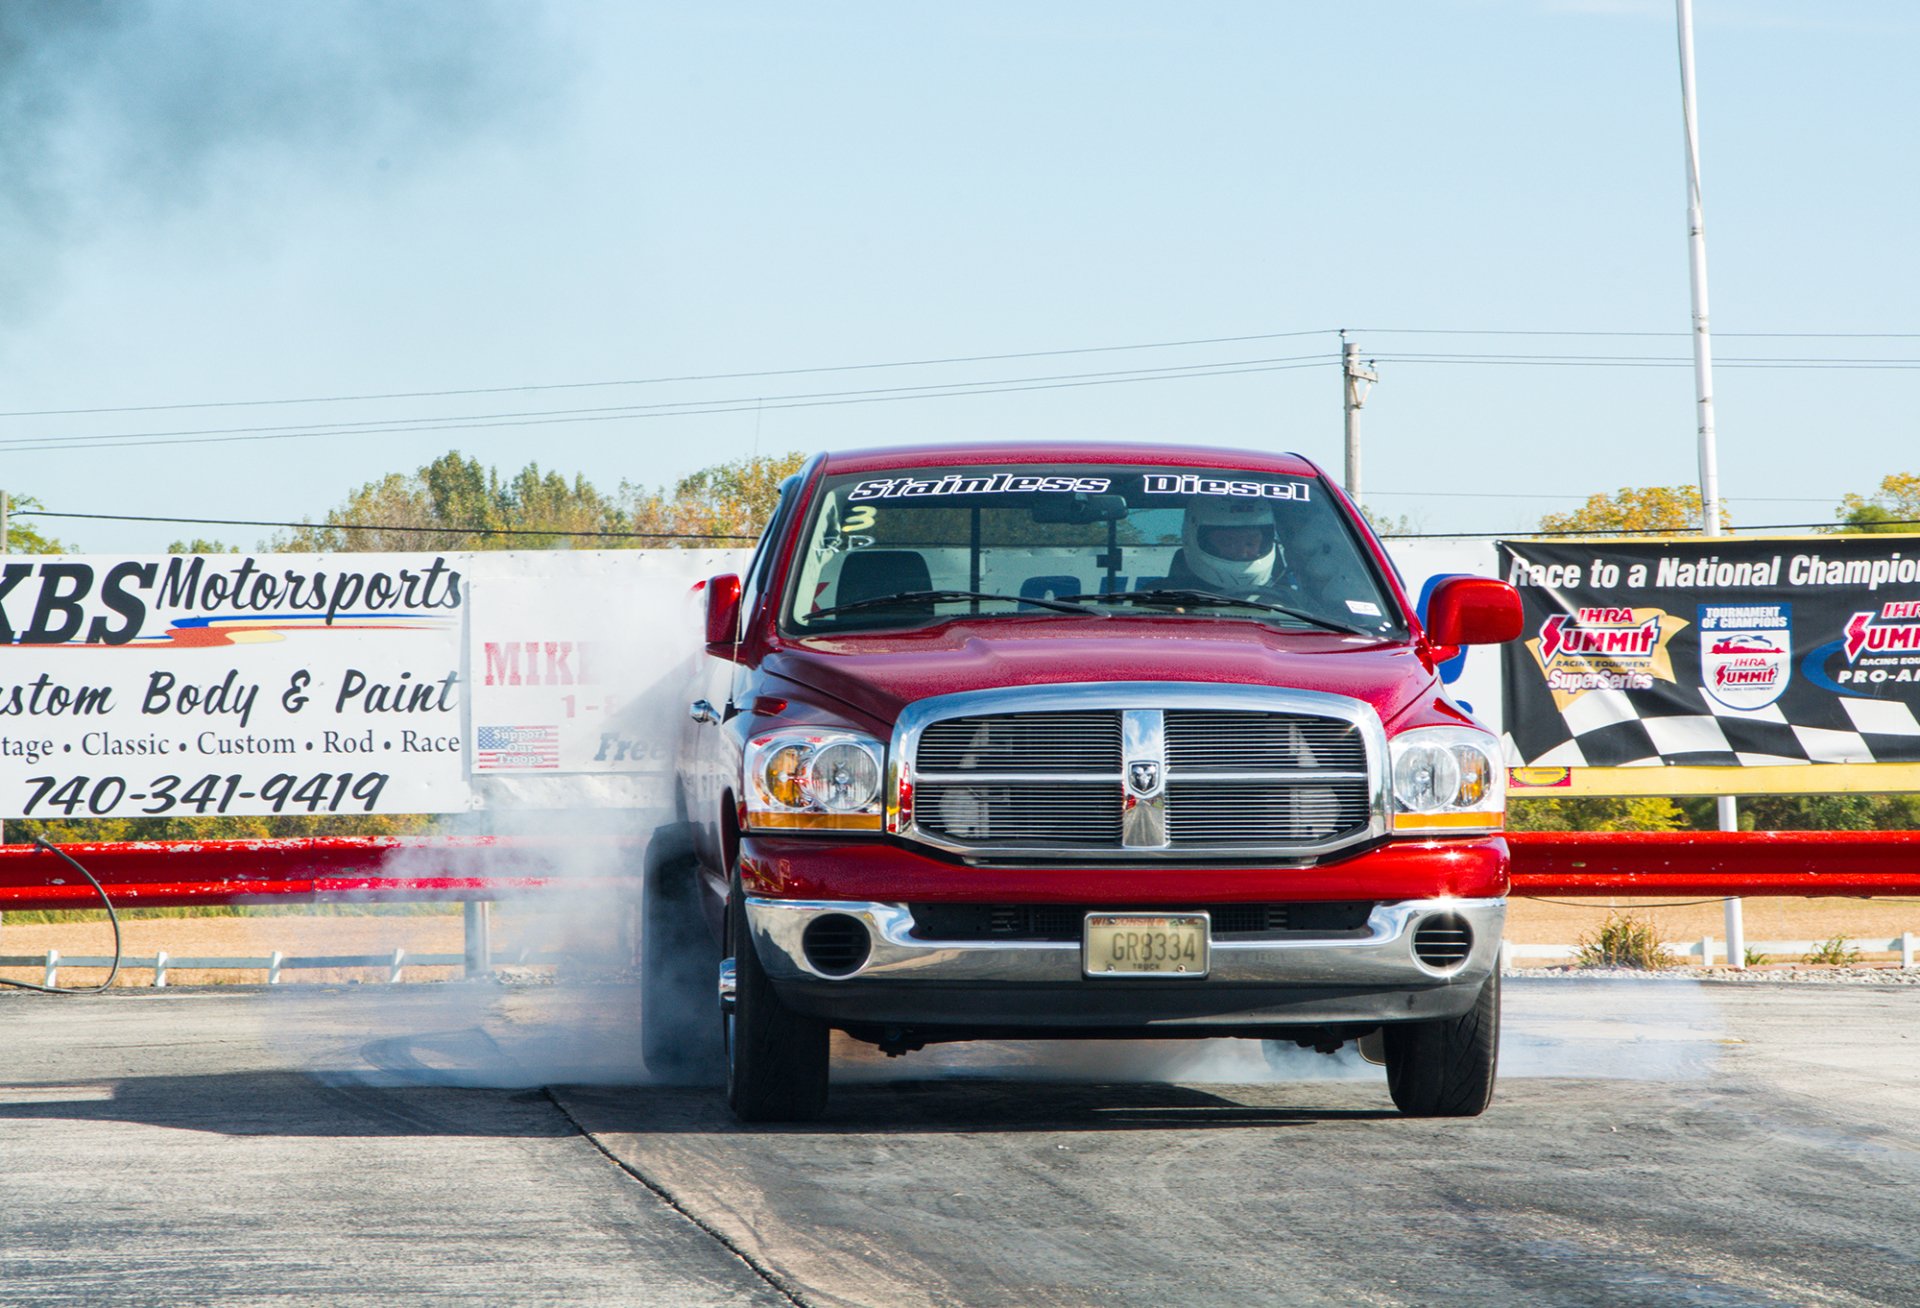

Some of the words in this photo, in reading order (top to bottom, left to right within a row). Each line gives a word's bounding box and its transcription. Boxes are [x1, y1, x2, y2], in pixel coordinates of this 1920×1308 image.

[848, 474, 1111, 500] Stainless
[1143, 474, 1310, 502] Diesel
[841, 506, 877, 532] 3
[1508, 556, 1582, 588] Race
[1590, 559, 1620, 588] to
[1627, 564, 1648, 588] a
[1655, 556, 1782, 587] National
[156, 556, 463, 626] Motorsports
[1576, 607, 1635, 624] IHRA
[1702, 618, 1718, 629] OF
[1720, 617, 1788, 629] CHAMPIONS
[1706, 606, 1781, 618] TOURNAMENT
[1595, 660, 1652, 668] EQUIPMENT
[1733, 658, 1767, 667] IHRA
[1547, 668, 1653, 694] SuperSeries
[0, 673, 117, 716] stom
[141, 669, 260, 728] Body
[282, 669, 312, 712] &
[335, 669, 464, 714] Paint
[1, 736, 54, 765] tage
[82, 731, 170, 756] Classic
[197, 730, 296, 756] Custom
[323, 730, 374, 755] Rod
[401, 730, 461, 754] Race
[493, 730, 547, 742] Support
[496, 753, 544, 765] Troops
[22, 772, 390, 816] 740-341-9419
[1092, 918, 1157, 926] WICONSIN
[1112, 932, 1196, 961] GR8334
